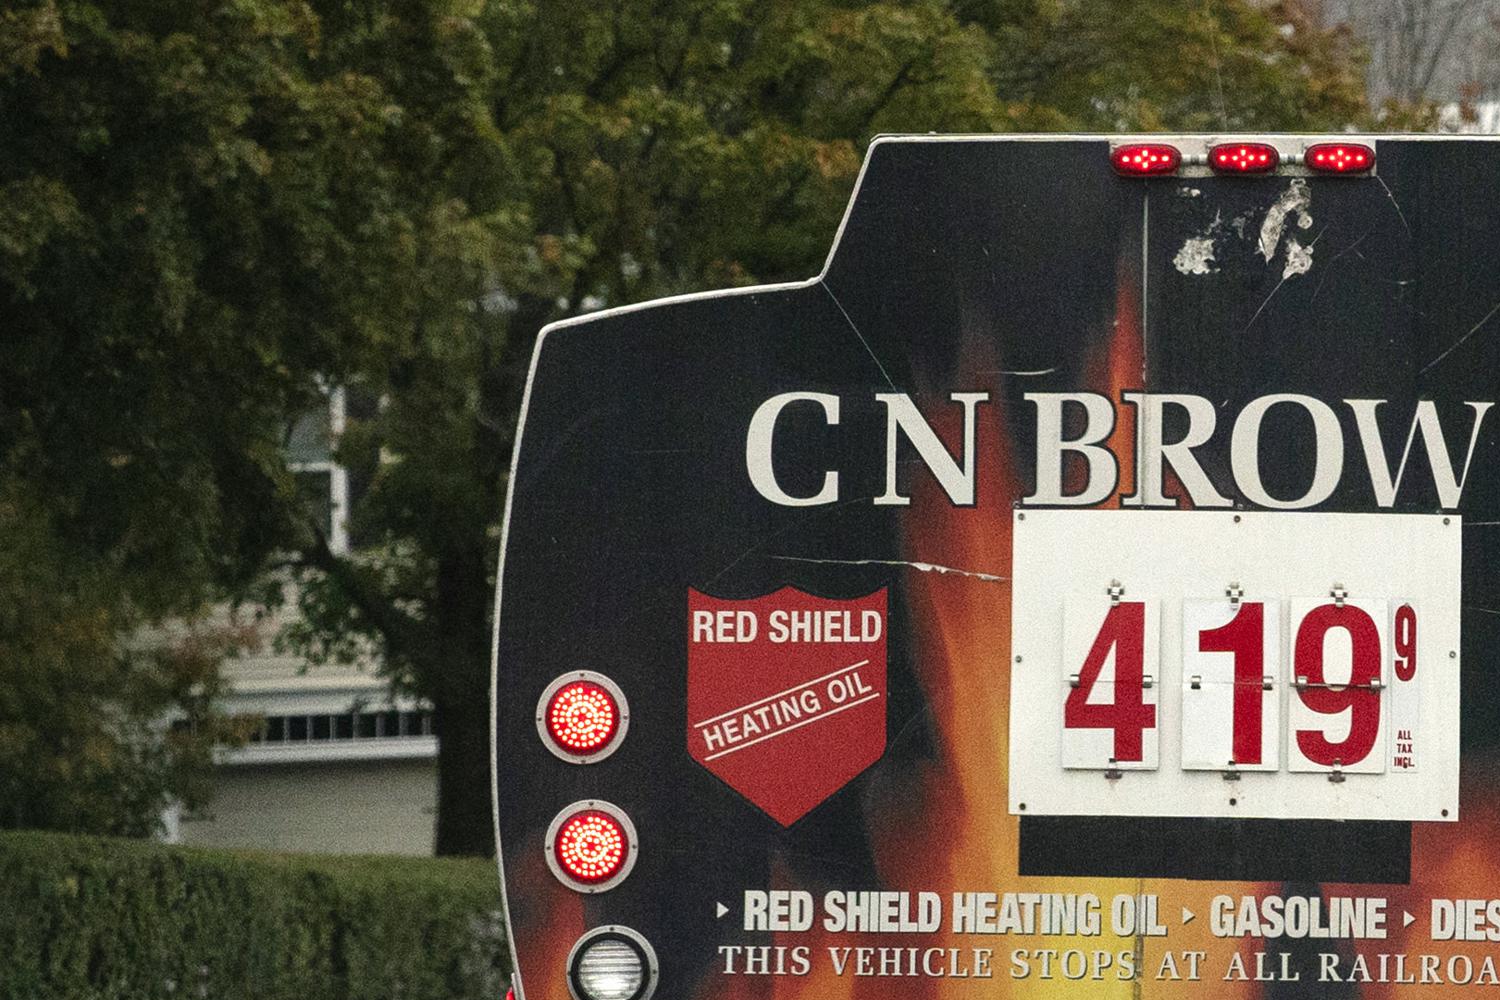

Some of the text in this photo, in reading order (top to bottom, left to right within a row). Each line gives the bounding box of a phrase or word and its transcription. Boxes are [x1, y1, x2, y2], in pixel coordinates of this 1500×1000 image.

[692, 609, 883, 643] RED SHIELD
[702, 672, 872, 751] HEATING OIL
[1396, 743, 1413, 753] TAX
[1397, 730, 1412, 740] ALL
[743, 889, 814, 932] RED
[823, 890, 942, 934] SHIELD
[952, 891, 1101, 937] HEATING
[1110, 893, 1168, 937] OIL
[1209, 894, 1388, 940] GASOLINE
[718, 944, 811, 976] THIS
[828, 946, 994, 979] VEHICLE
[1009, 948, 1137, 982] STOPS
[1155, 950, 1207, 981] AT
[1223, 951, 1300, 983] ALL
